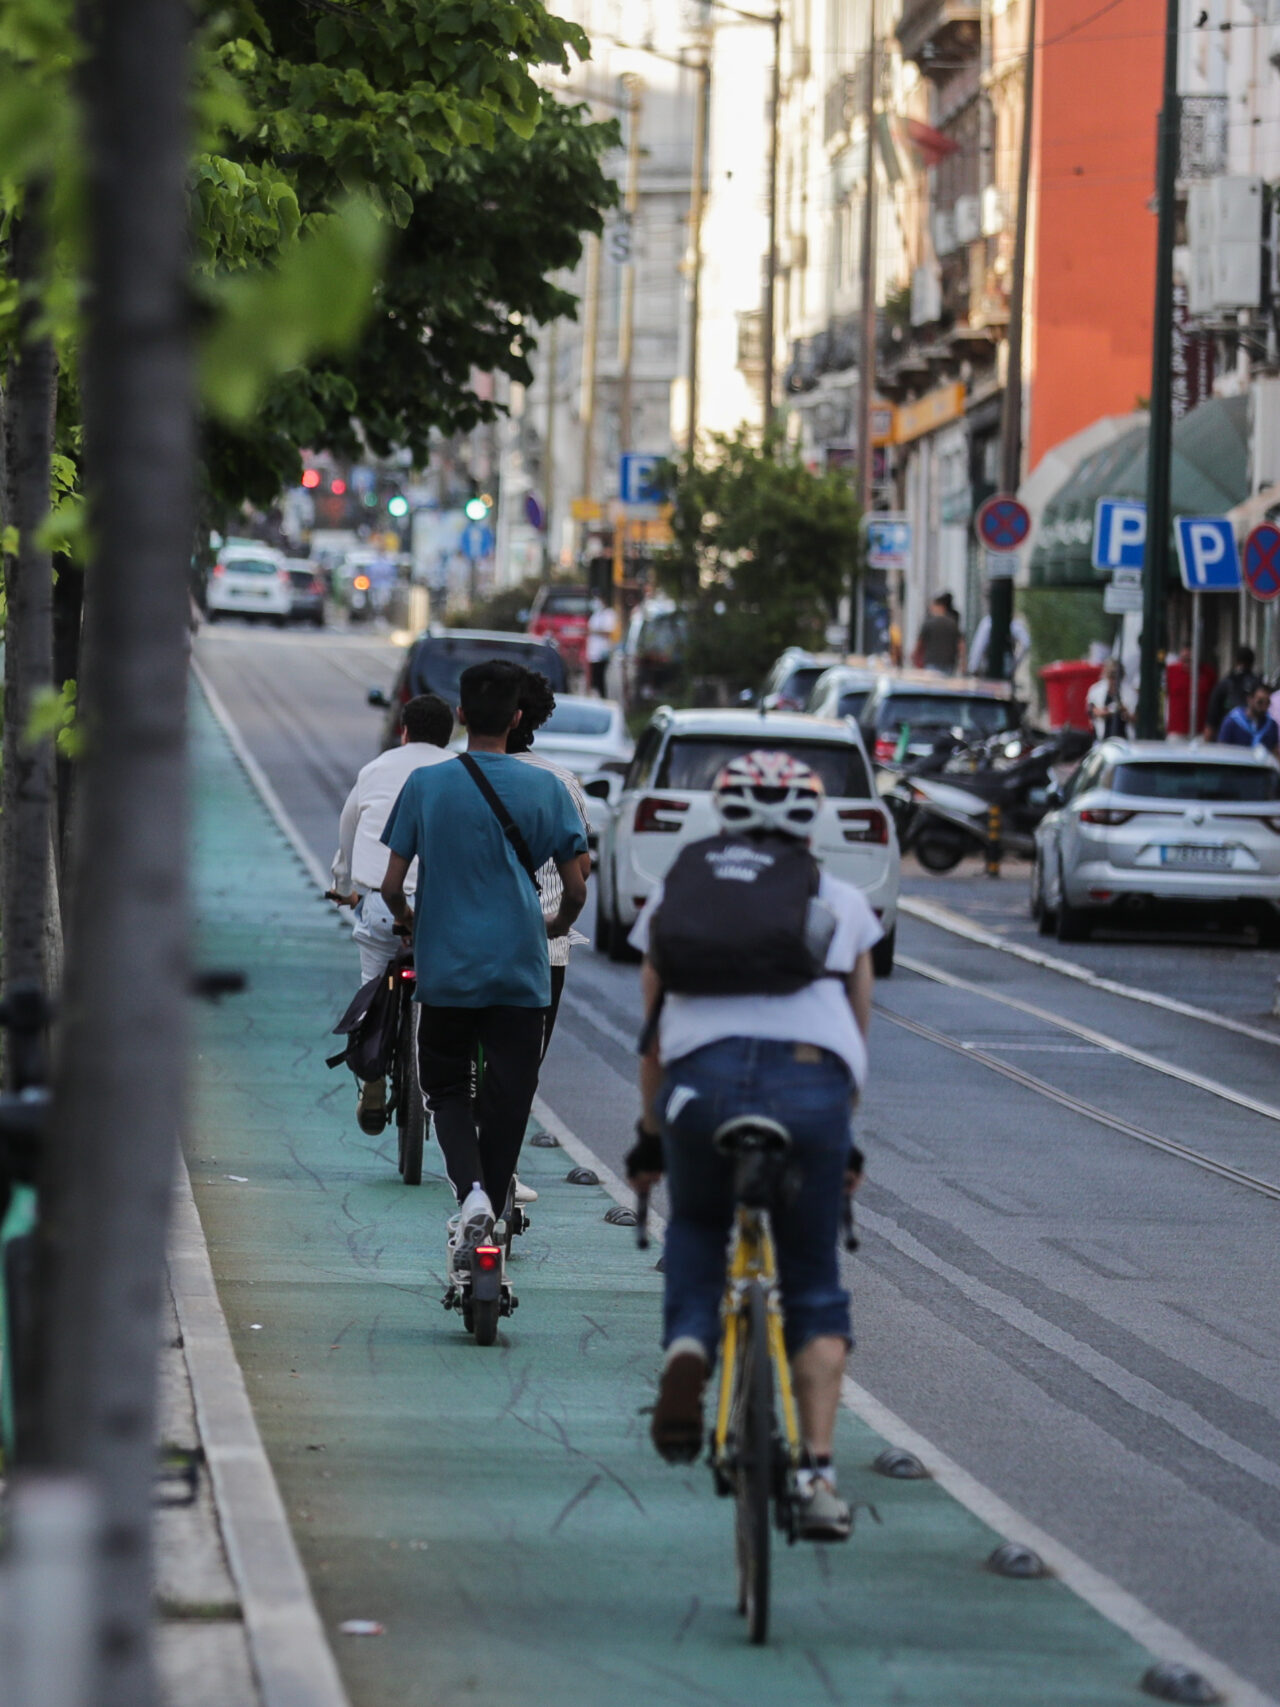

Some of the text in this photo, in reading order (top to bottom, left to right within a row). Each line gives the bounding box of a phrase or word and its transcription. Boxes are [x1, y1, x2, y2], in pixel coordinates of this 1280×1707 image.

[611, 231, 631, 261] S
[1108, 507, 1146, 565] P
[1189, 523, 1225, 584] P
